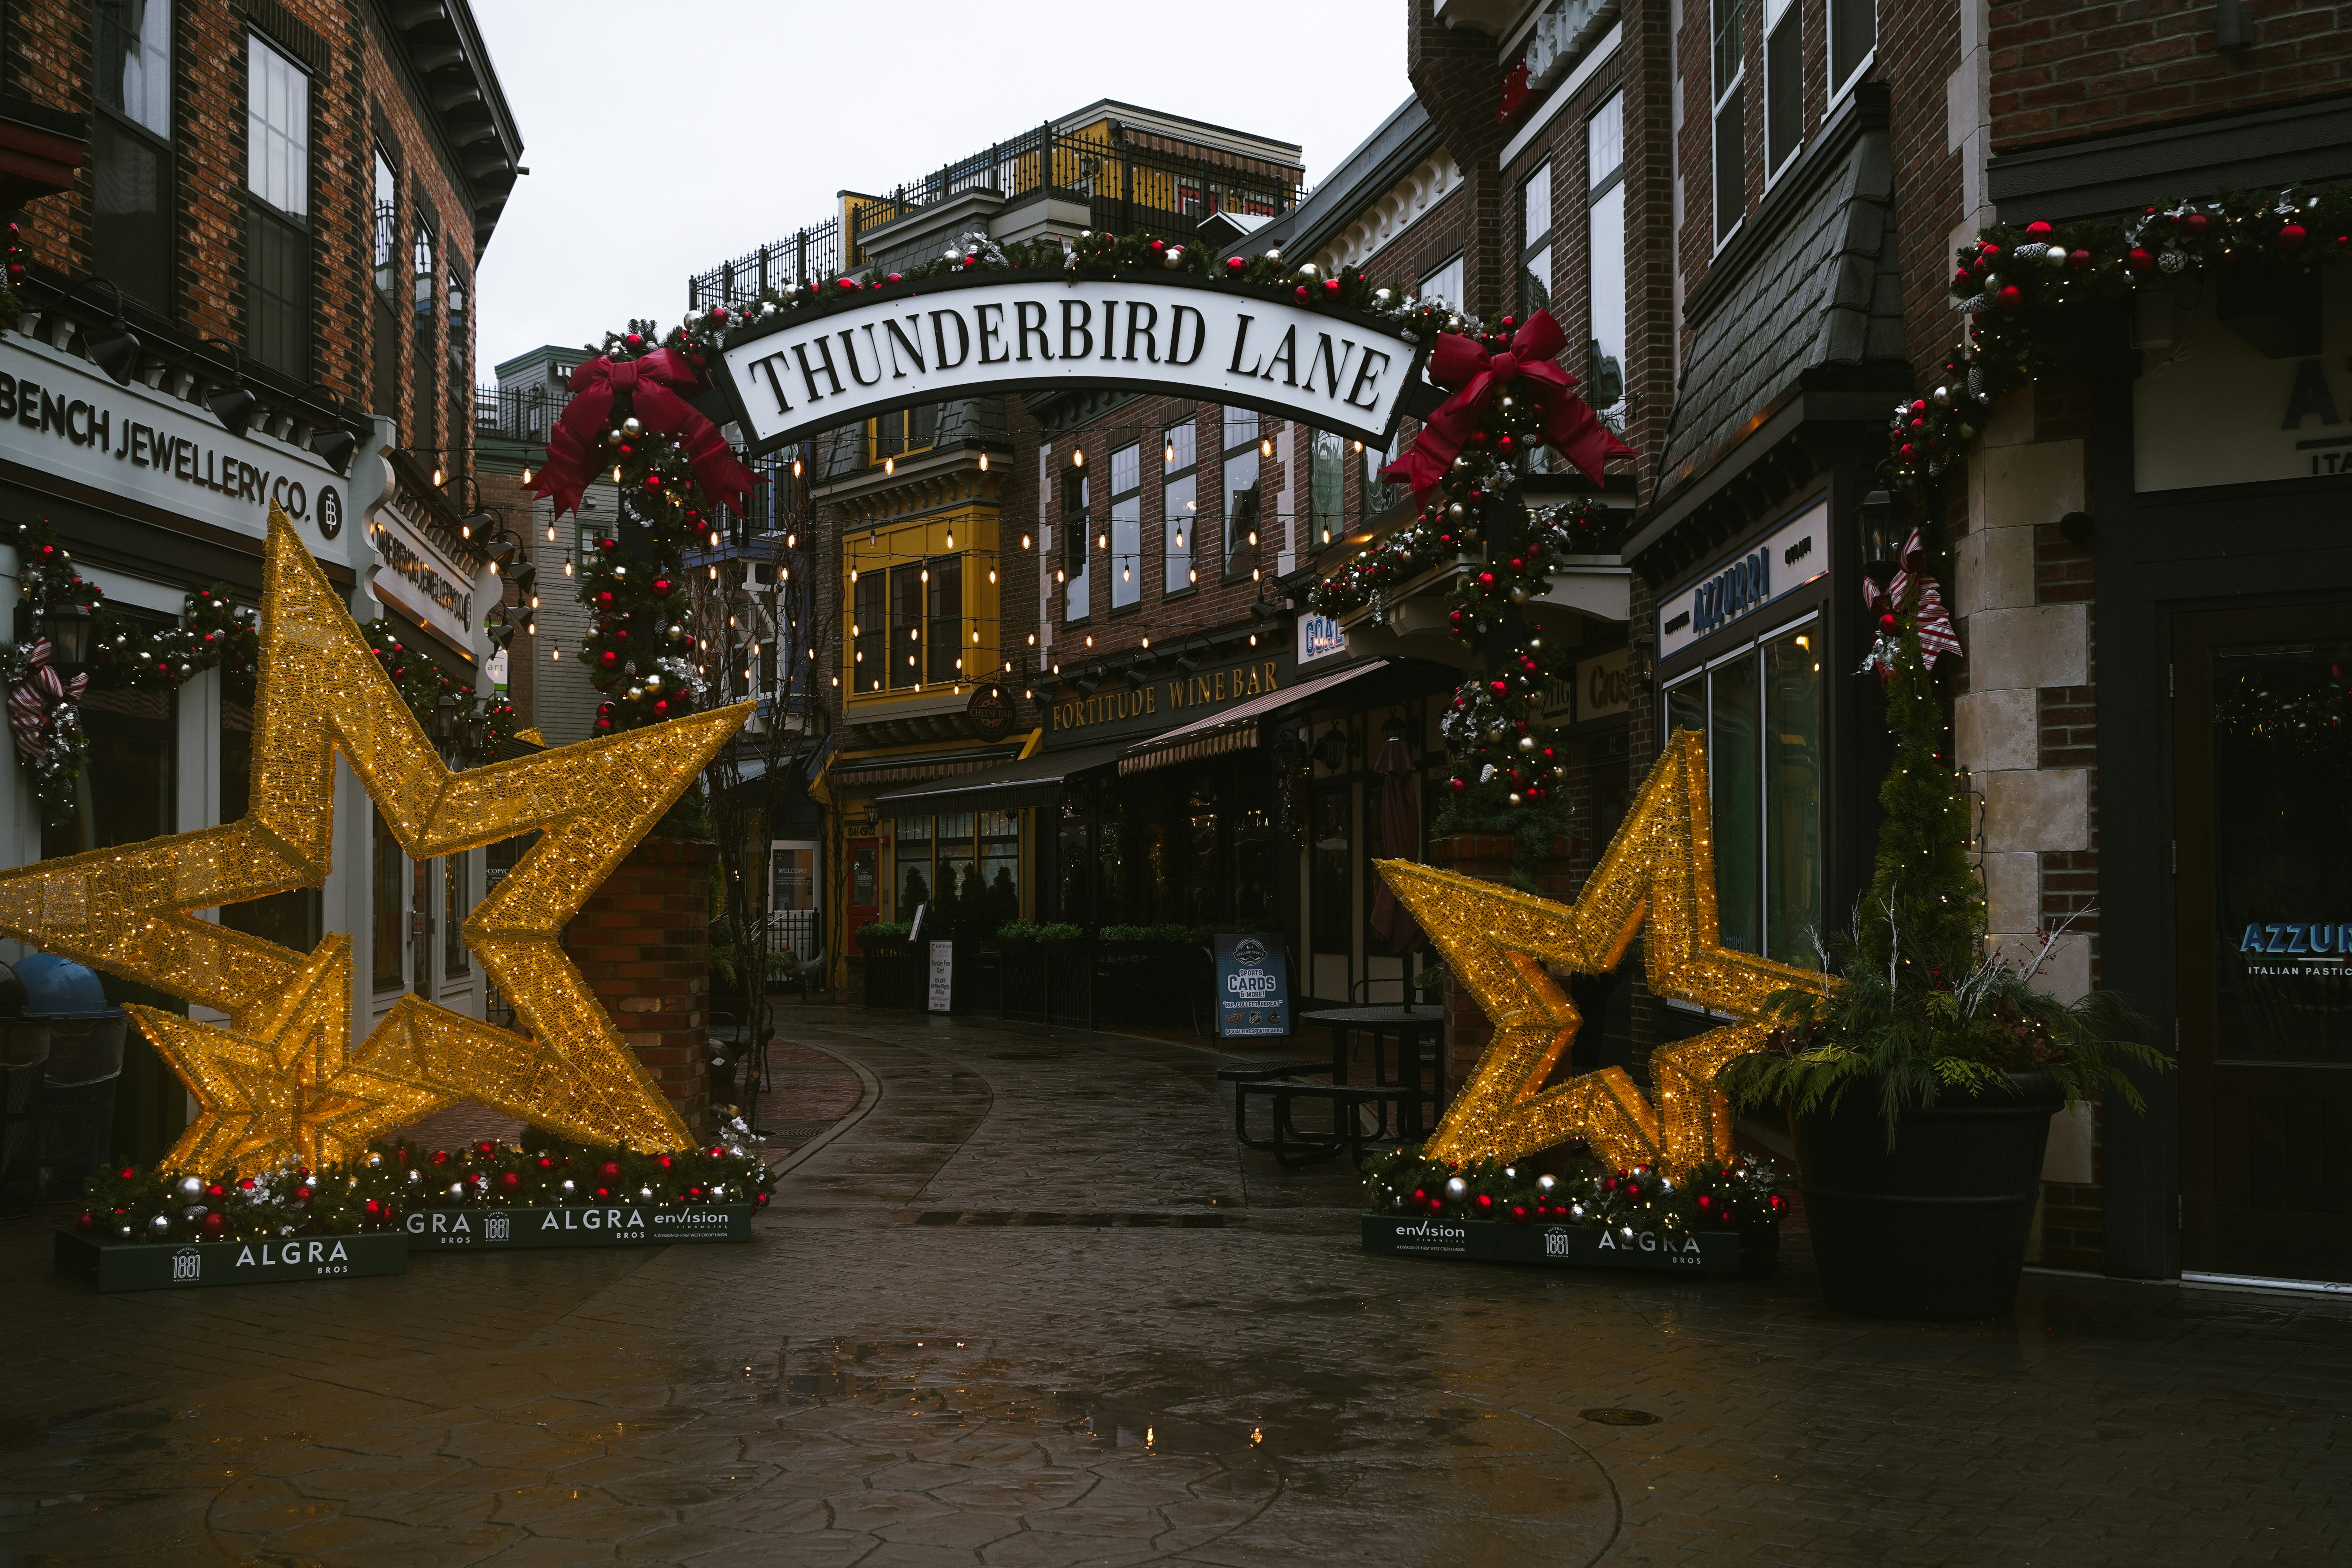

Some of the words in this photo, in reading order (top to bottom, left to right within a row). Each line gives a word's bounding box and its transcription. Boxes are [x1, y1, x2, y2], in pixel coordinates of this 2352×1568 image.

[748, 299, 1206, 416] THUNDERBIRD
[1226, 314, 1390, 412] LANE
[0, 371, 110, 452] BENCH
[116, 418, 270, 505] JEWELLERY
[274, 476, 311, 522] CO.
[1693, 546, 1769, 633] AZZURRI
[1053, 686, 1156, 731] FORTITUDE
[1169, 672, 1226, 709] WINE
[1233, 662, 1278, 698] BAR
[970, 708, 997, 718] CHEESE
[998, 710, 1013, 719] BAR
[2248, 966, 2299, 975] ITALIAN
[1229, 976, 1274, 991] CARDS
[407, 1212, 471, 1234] GRA
[484, 1218, 509, 1239] 1881
[541, 1208, 645, 1230] ALGRA
[1544, 1234, 1568, 1255] 1881
[1598, 1229, 1701, 1253] AGRA
[235, 1240, 348, 1268] ALGRA
[1672, 1256, 1701, 1265] BROS
[172, 1255, 201, 1278] 1881
[317, 1265, 348, 1275] BROS
